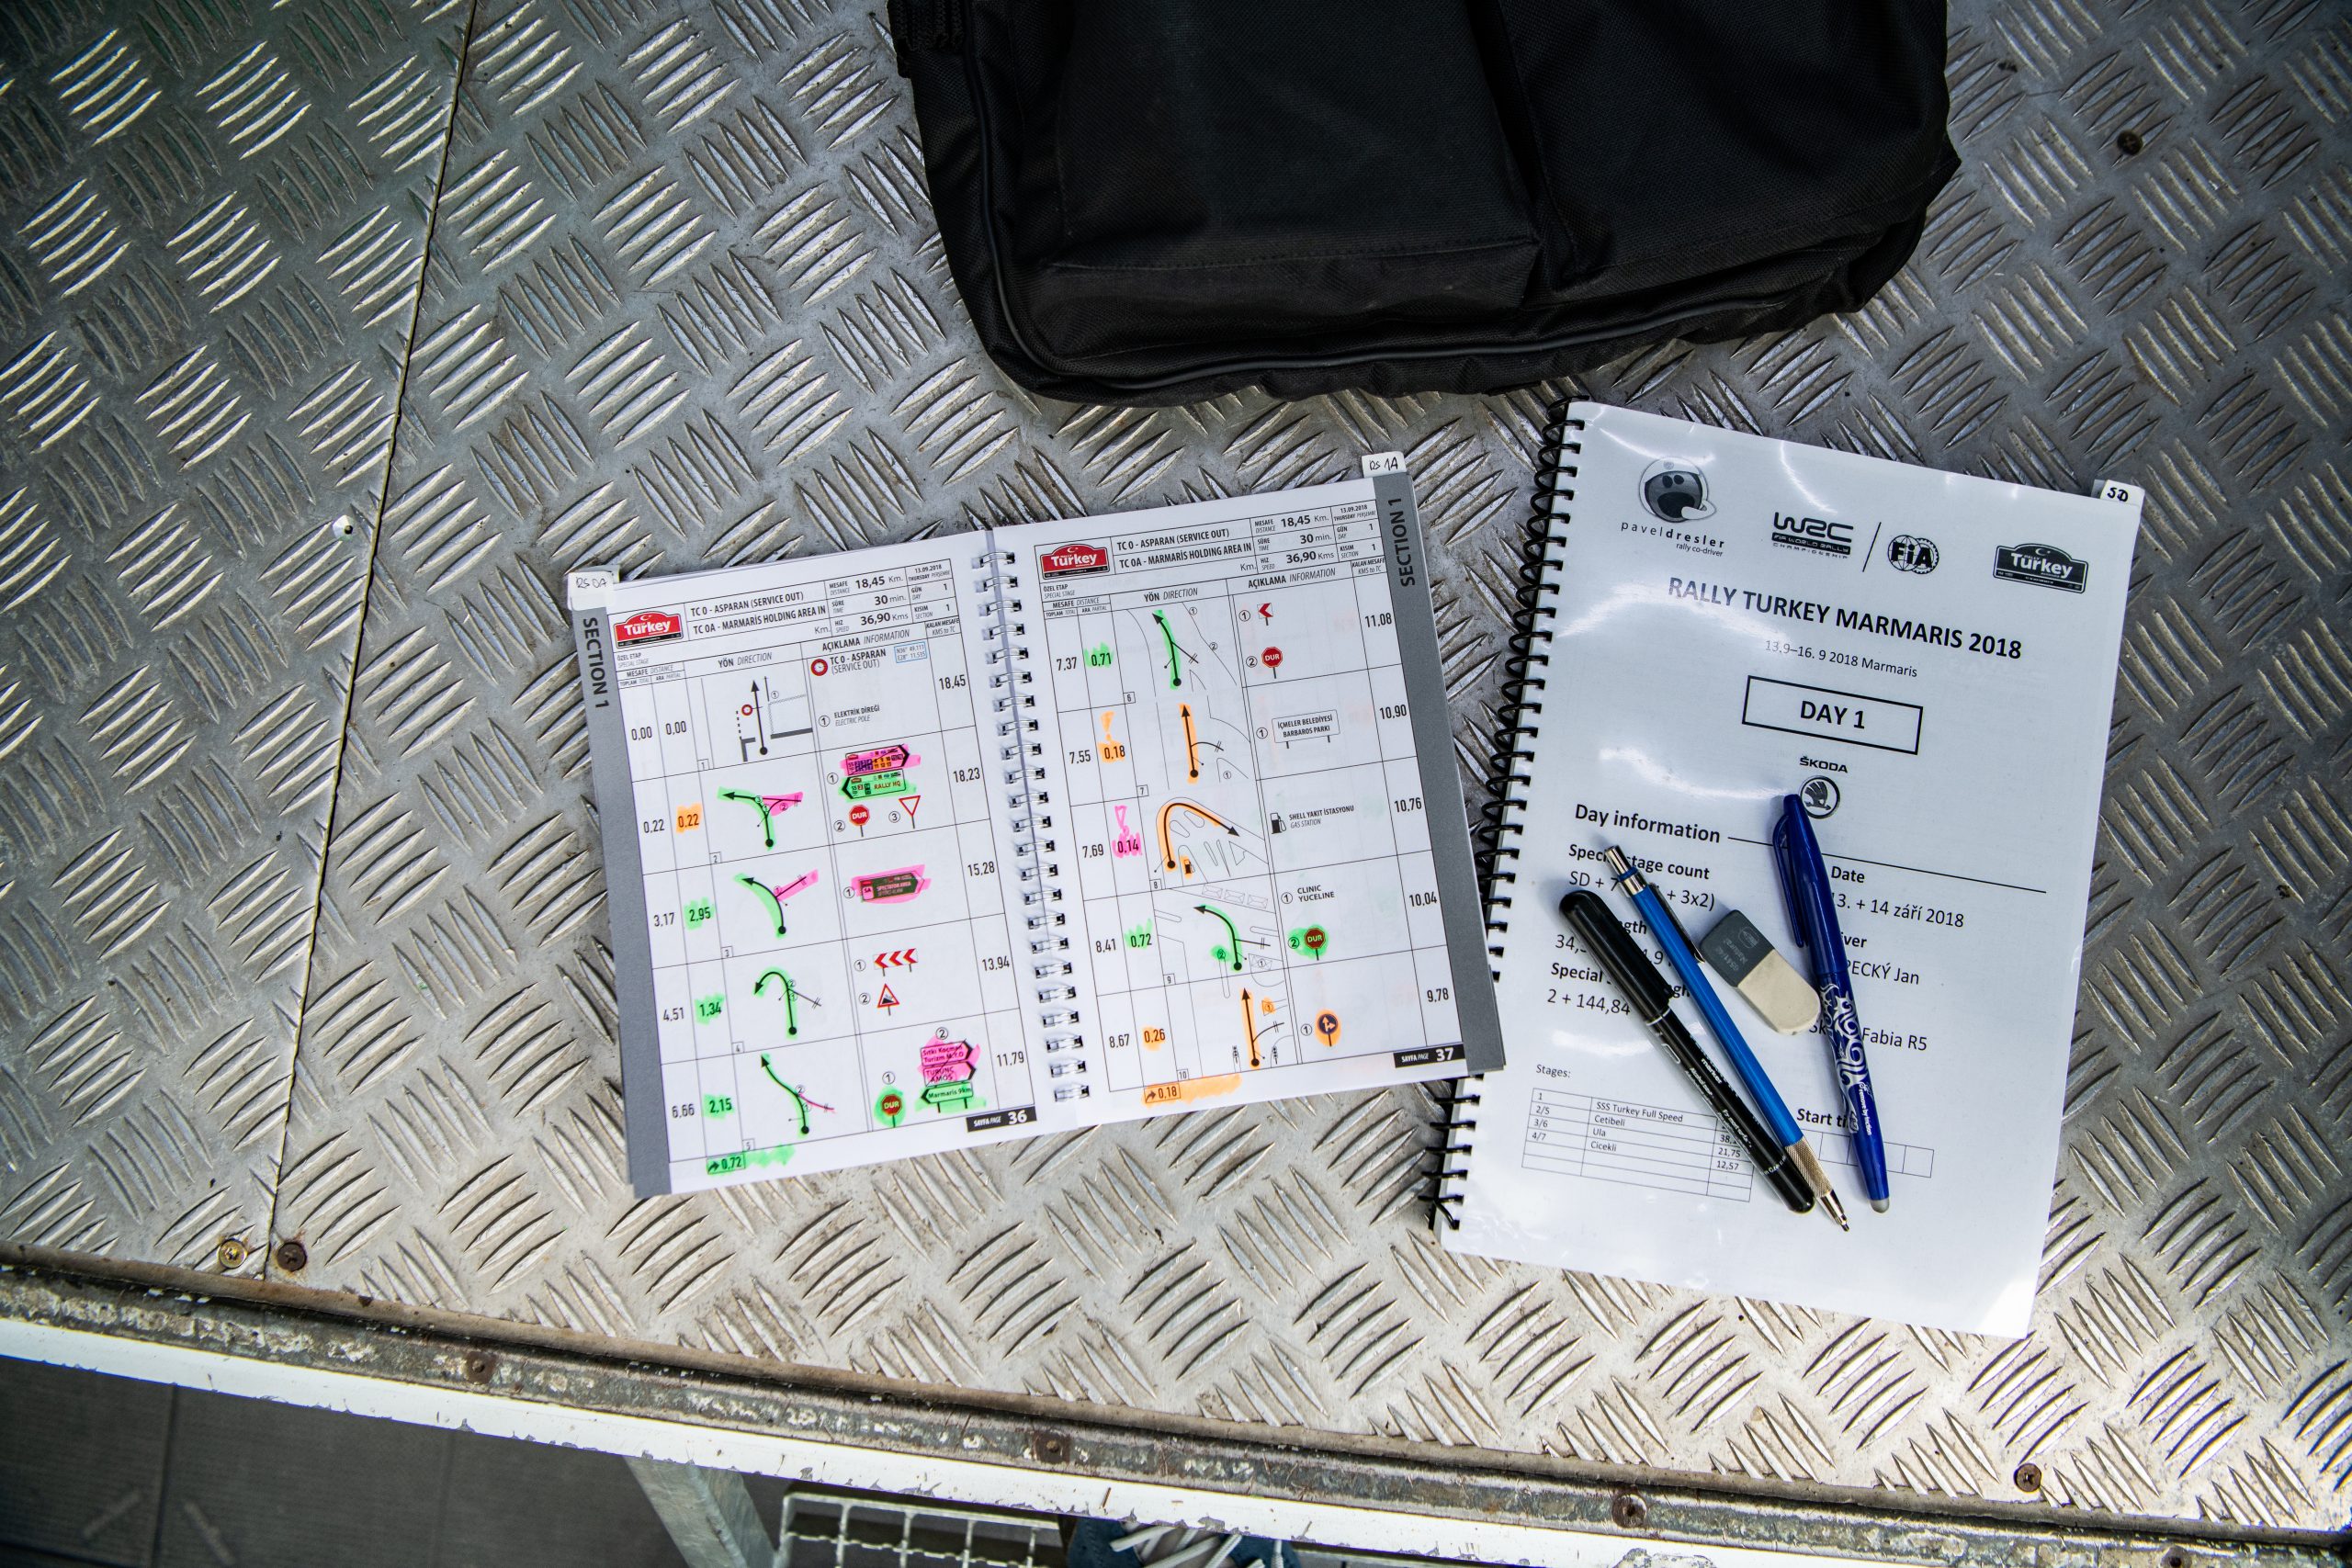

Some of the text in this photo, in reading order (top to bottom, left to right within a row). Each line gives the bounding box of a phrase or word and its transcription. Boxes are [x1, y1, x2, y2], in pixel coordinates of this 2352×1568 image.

[1281, 515, 1310, 527] 18,45
[1773, 512, 1854, 543] WRC
[1117, 541, 1127, 550] TC
[1140, 536, 1174, 547] ASPARAN
[1176, 532, 1209, 545] (SERVICE
[1211, 529, 1229, 539] OUT)
[1300, 534, 1314, 544] 30
[1120, 559, 1130, 568] TC
[1190, 547, 1222, 558] HOLDING
[1224, 544, 1242, 554] AREA
[1243, 542, 1251, 551] IN
[1286, 551, 1317, 563] 36,90
[1390, 513, 1415, 586] SECTION
[1676, 543, 1723, 558] rally co-driver
[1051, 553, 1097, 568] Turkey
[2010, 552, 2074, 579] Turkey
[1249, 568, 1336, 588] AÇIKLAMA INFORMATION
[691, 607, 700, 616] TC
[715, 601, 749, 613] ASPARAN
[752, 593, 784, 607] (SERVICE
[785, 591, 804, 604] OUT)
[1144, 588, 1198, 603] YÖN DIRECTION
[624, 620, 671, 636] Turkey
[694, 626, 704, 634] TC
[763, 610, 796, 624] HOLDING
[798, 607, 816, 618] AREA
[819, 605, 826, 614] IN
[1668, 577, 2022, 660] RALLY TURKEY MARMARIS 2018
[582, 617, 607, 695] SECTION
[1818, 650, 1826, 661] 9
[1829, 652, 1859, 667] 2018
[1861, 657, 1917, 678] Marmaris
[1800, 700, 1865, 729] DAY 1
[1283, 728, 1312, 737] BARBAROS
[1799, 755, 1848, 773] ŠKODA
[852, 811, 866, 819] DUR
[1289, 812, 1306, 820] SHELL
[1307, 810, 1322, 818] YAKIT
[1301, 818, 1321, 827] STATION
[1576, 804, 1721, 843] Day information
[1668, 861, 1710, 880] count
[1830, 865, 1865, 883] Date
[1297, 885, 1322, 894] CLINIC
[1298, 891, 1335, 902] YUCELINE
[1569, 871, 1590, 886] SD
[1595, 879, 1604, 888] +
[1667, 890, 1676, 899] +
[1680, 889, 1714, 911] 3x2)
[1856, 900, 1865, 910] +
[1871, 900, 1889, 915] 14
[1894, 905, 1921, 920] září
[1927, 909, 1964, 928] 2018
[1307, 933, 1323, 942] DUR
[1551, 963, 1603, 983] Special
[1894, 968, 1919, 985] Jan
[1547, 989, 1631, 1015] 2 + 144,84
[1861, 1027, 1927, 1051] Fabia R5
[1436, 1047, 1453, 1062] 37
[1536, 1065, 1571, 1078] Stages:
[1700, 1056, 1724, 1085] marker
[1859, 1089, 1867, 1109] remove
[1008, 1111, 1027, 1125] 36
[1536, 1105, 1625, 1126] 2/5 Cetibeli
[1597, 1102, 1611, 1111] SSS
[1612, 1104, 1640, 1118] Turkey
[1642, 1109, 1657, 1118] Full
[1658, 1111, 1683, 1124] Speed
[1797, 1108, 1831, 1125] Start
[1534, 1119, 1741, 1158] 3/6 Ula 21,75
[1532, 1132, 1739, 1171] 4/7 Cicekli 12,57
